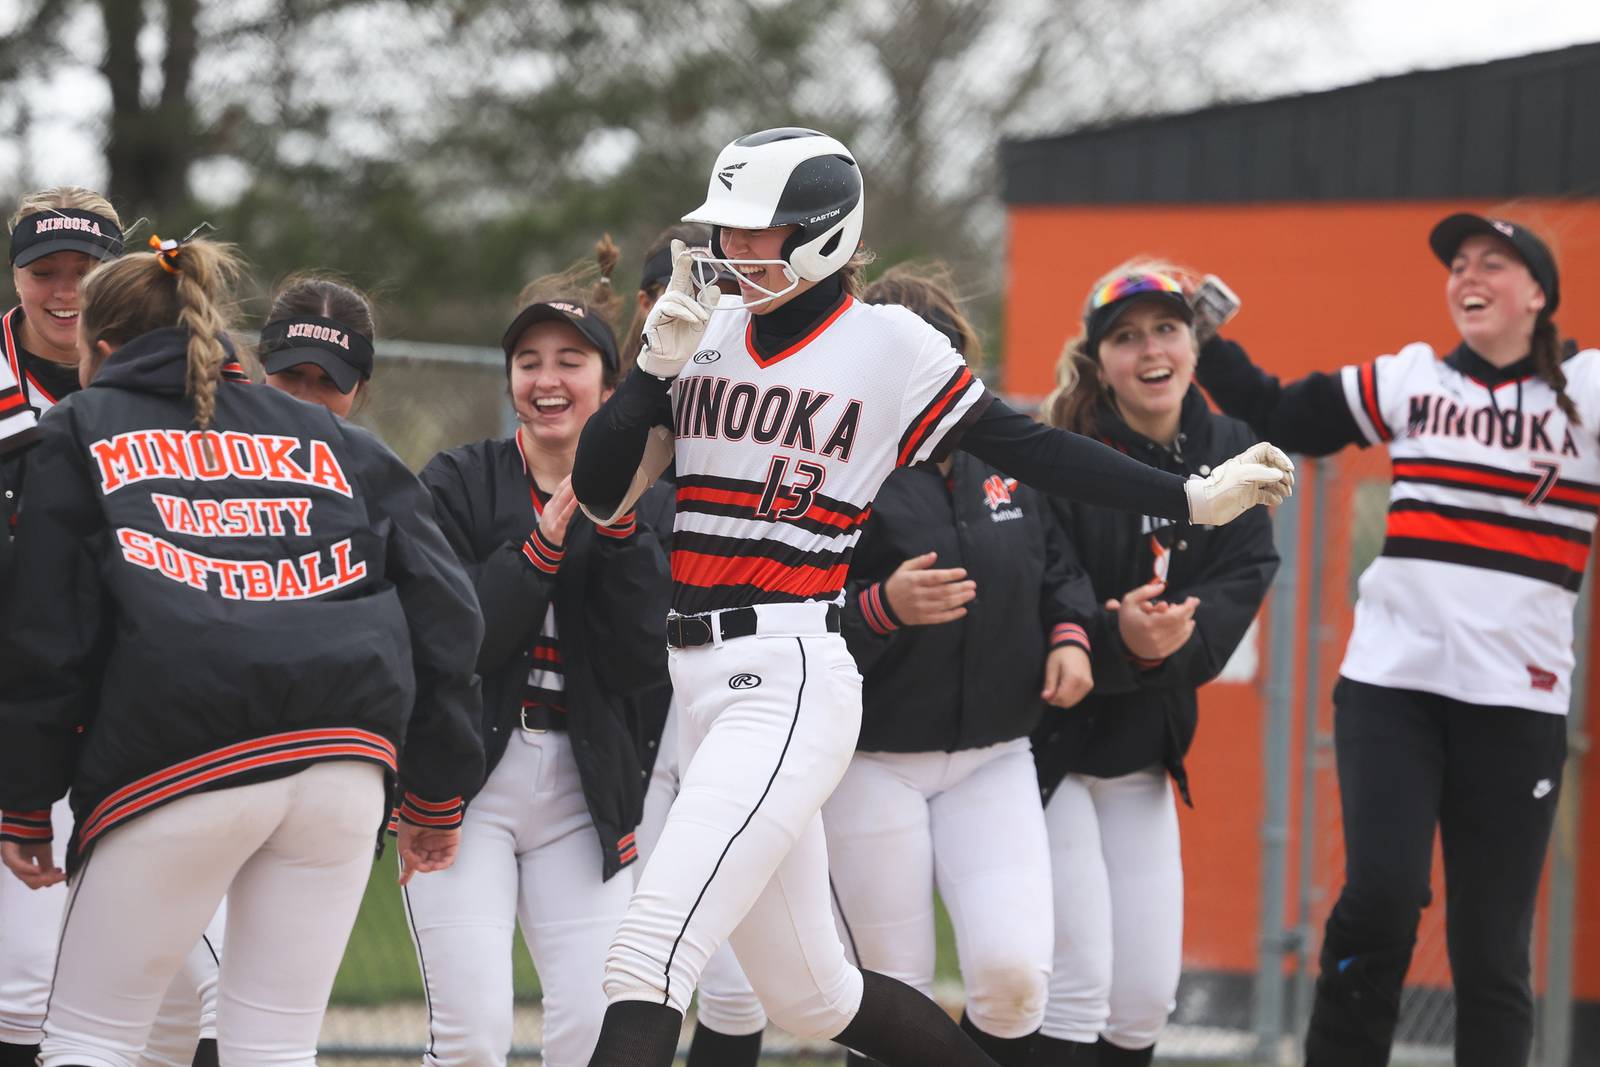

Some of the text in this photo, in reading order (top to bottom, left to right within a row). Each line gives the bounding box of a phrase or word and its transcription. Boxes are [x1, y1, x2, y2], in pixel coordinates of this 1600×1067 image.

[36, 217, 101, 237] MINOOKA
[810, 208, 841, 223] EASTON
[286, 323, 350, 350] MINOOKA
[1407, 395, 1579, 458] MINOOKA
[90, 429, 353, 499] MINOOKA
[1522, 460, 1560, 508] 7
[753, 455, 826, 522] 13
[151, 493, 312, 537] VARSITY
[116, 527, 367, 601] SOFTBALL
